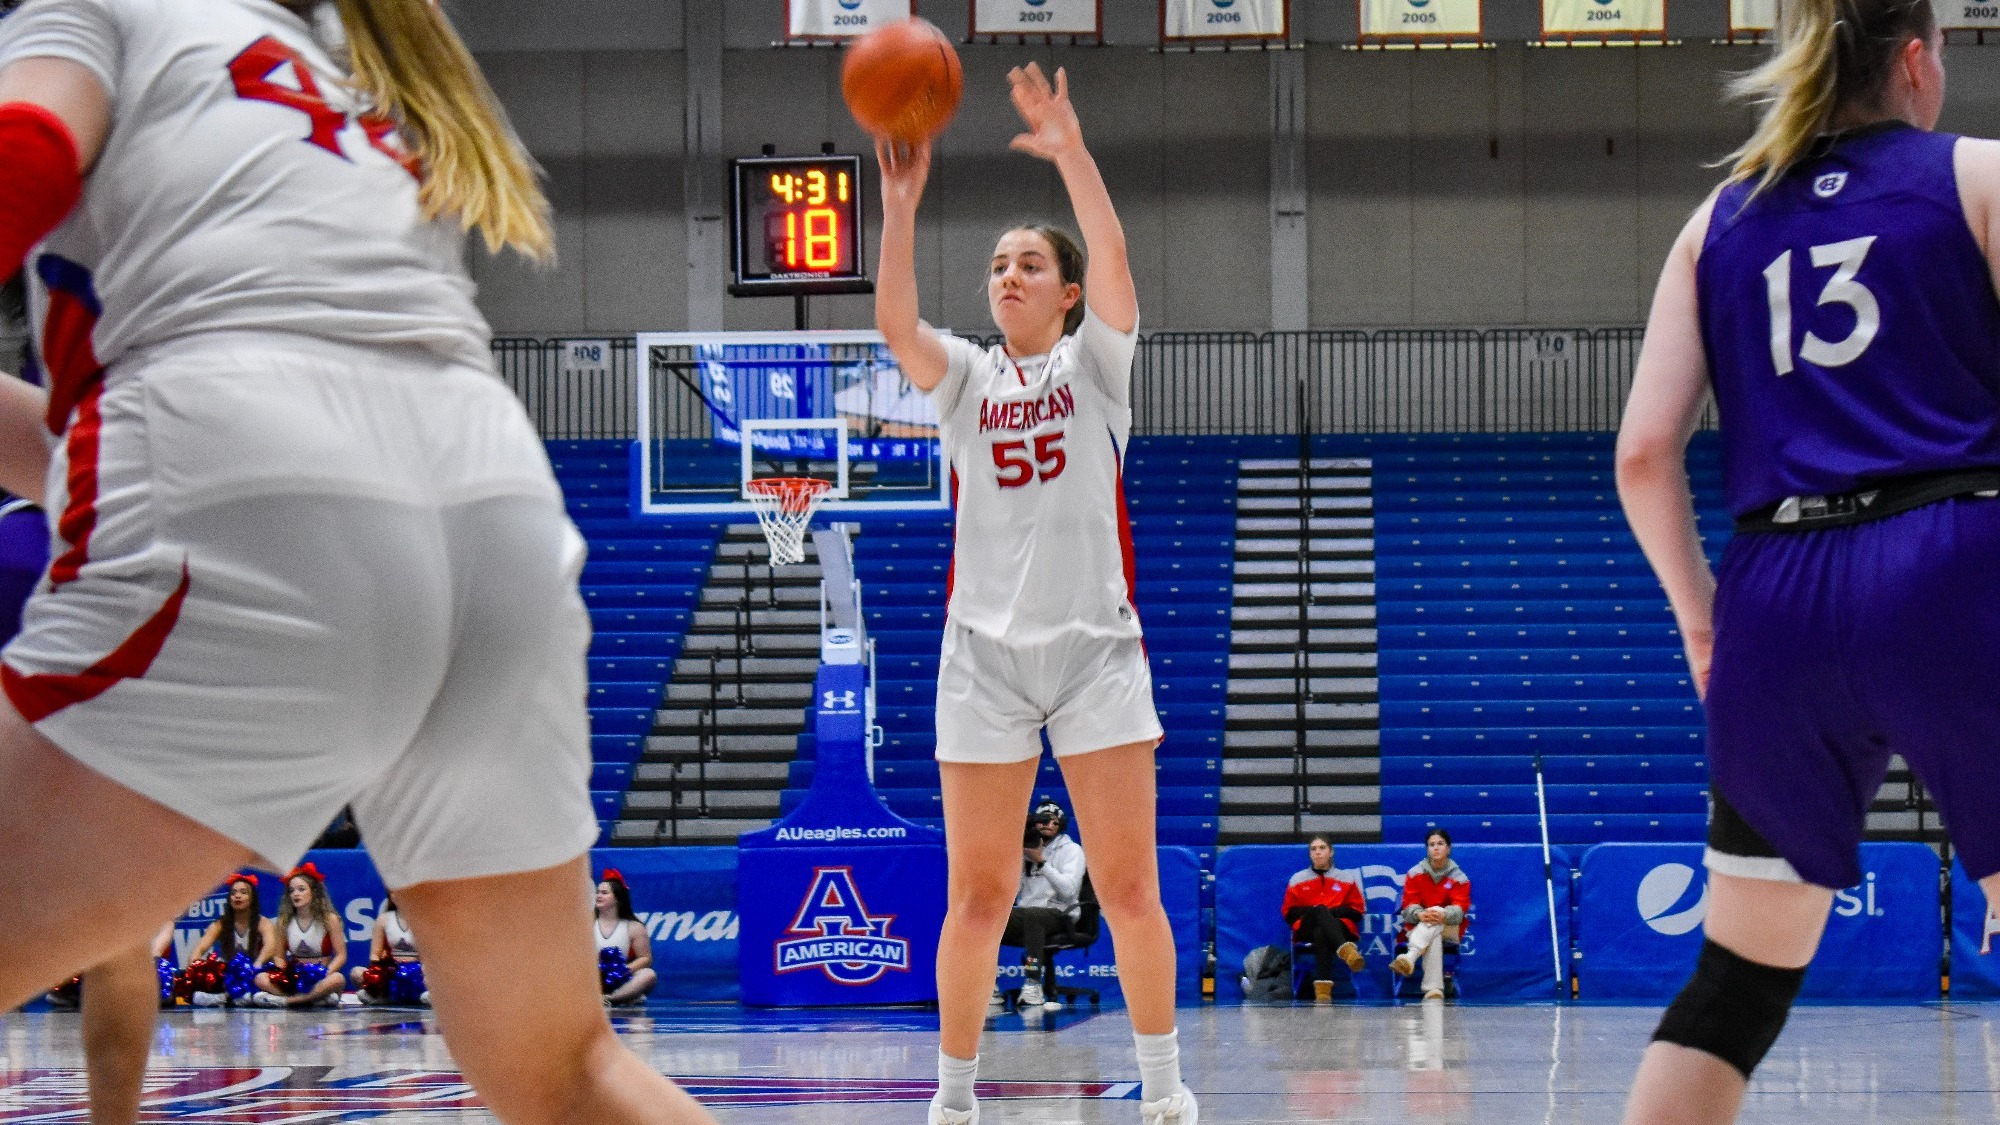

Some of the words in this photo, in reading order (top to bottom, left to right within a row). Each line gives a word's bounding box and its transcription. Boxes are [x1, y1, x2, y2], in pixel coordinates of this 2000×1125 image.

[1019, 11, 1054, 22] 2007
[1206, 12, 1241, 23] 2006
[1402, 12, 1437, 23] 2005
[1587, 9, 1621, 21] 2004
[1963, 6, 1999, 18] 2002
[833, 14, 868, 26] 2008
[771, 170, 848, 205] 4:31
[786, 209, 838, 268] 18
[1763, 235, 1881, 377] 13
[991, 430, 1067, 489] 55
[775, 825, 907, 842] AUeagles.com
[783, 940, 902, 963] AMERICAN
[997, 965, 1075, 978] POTAC
